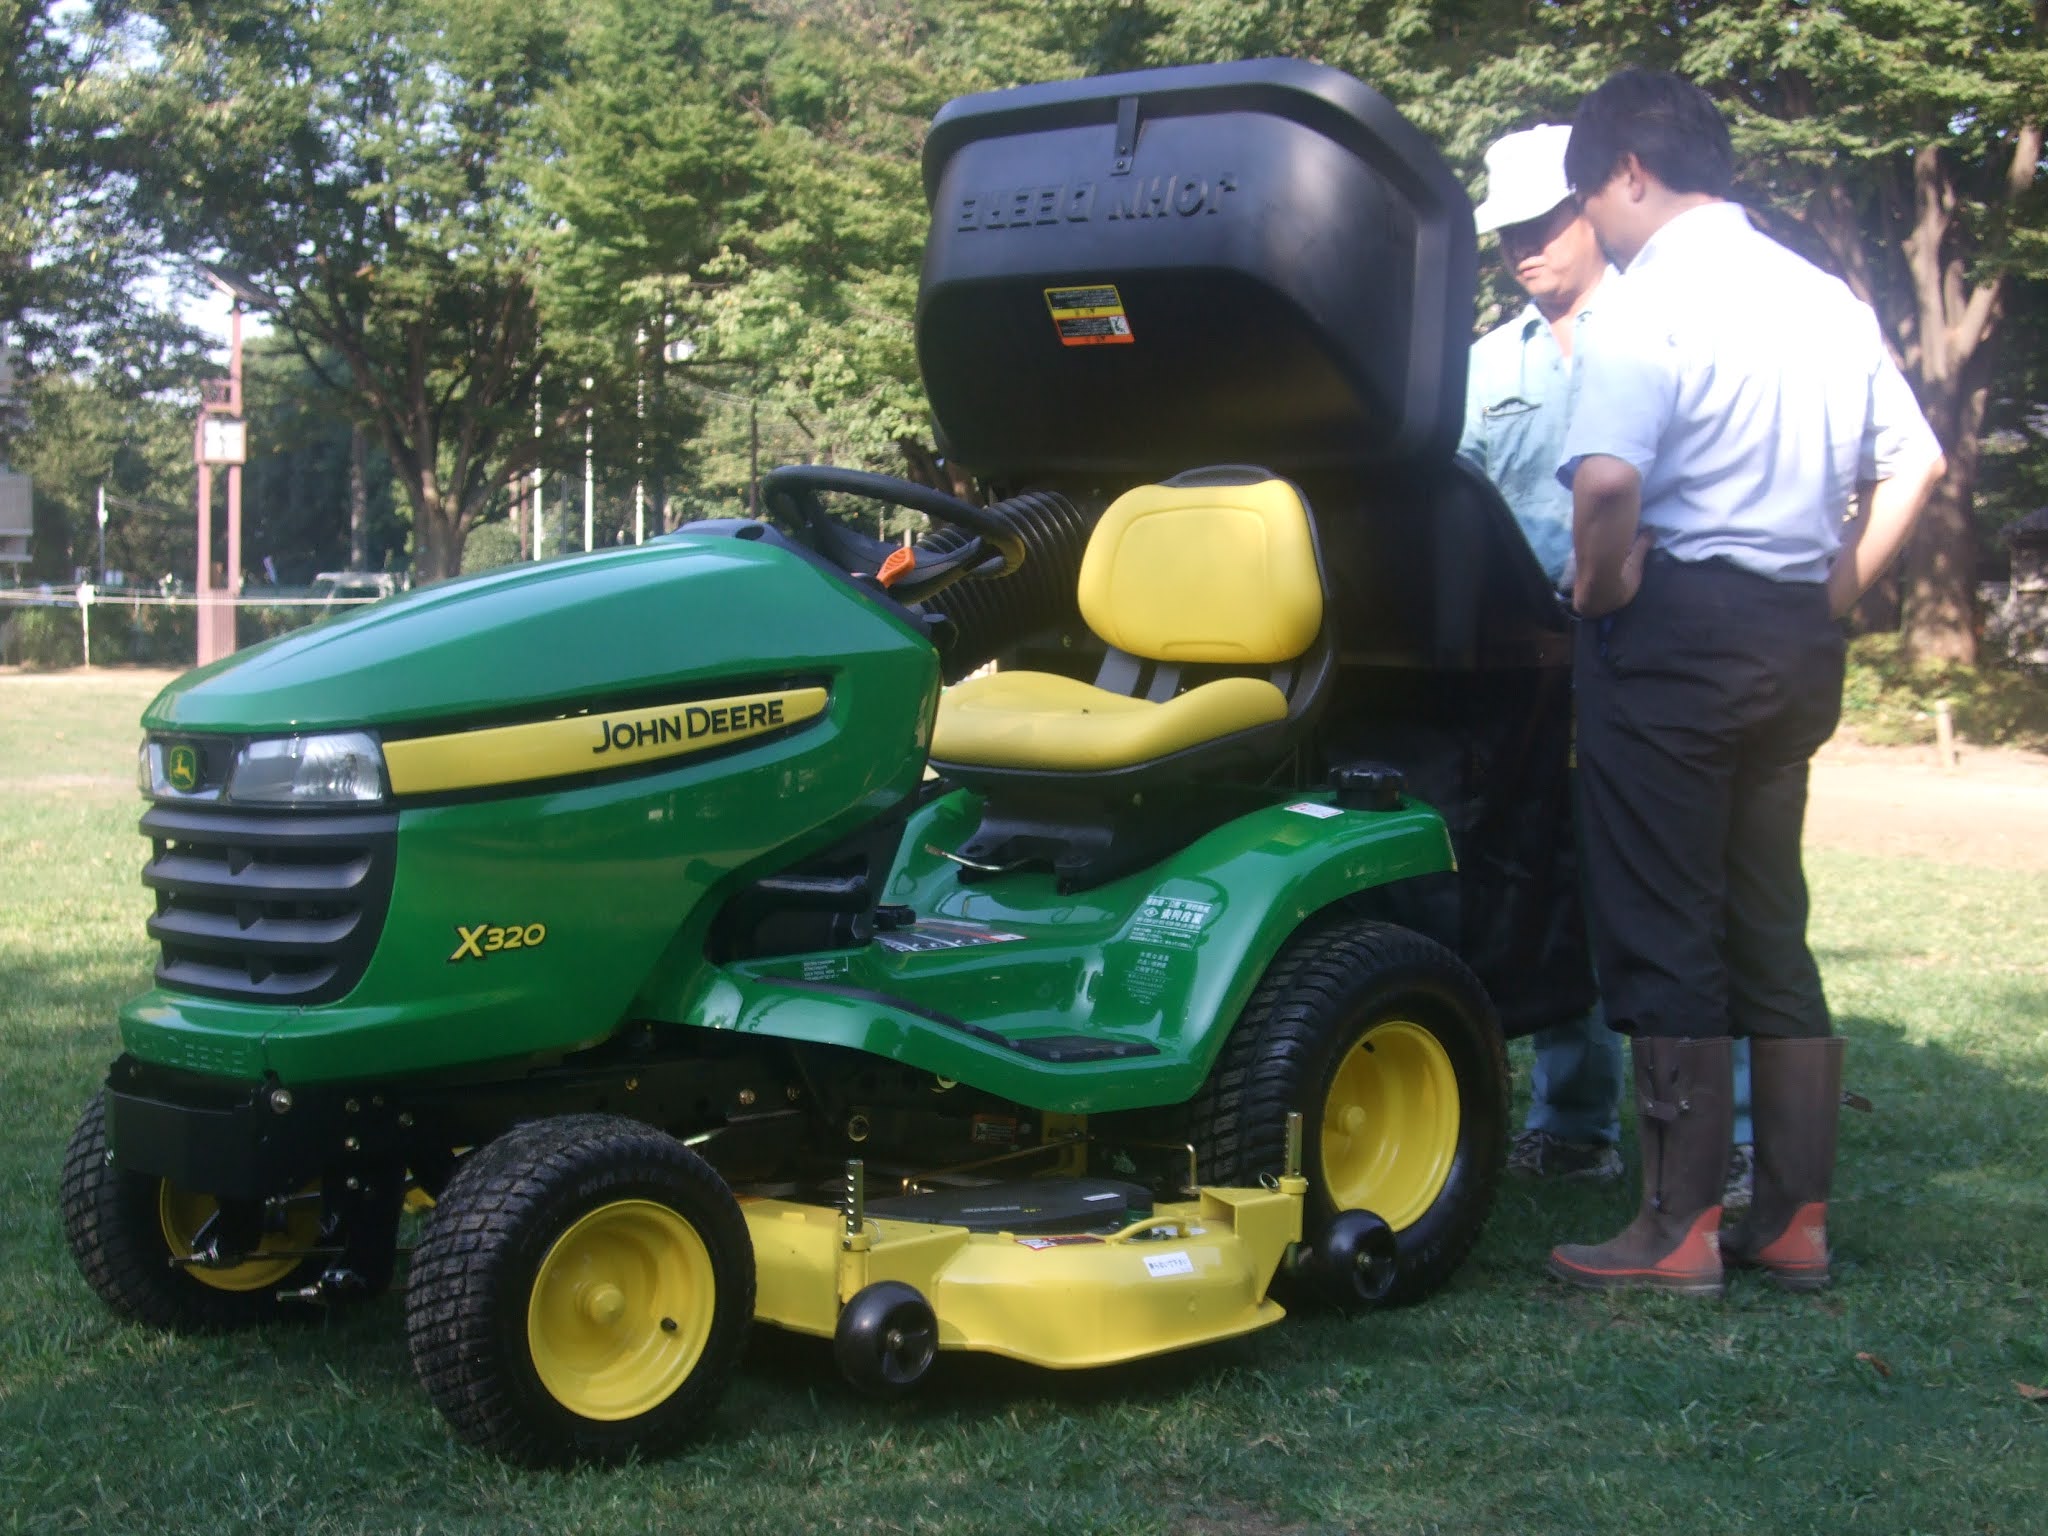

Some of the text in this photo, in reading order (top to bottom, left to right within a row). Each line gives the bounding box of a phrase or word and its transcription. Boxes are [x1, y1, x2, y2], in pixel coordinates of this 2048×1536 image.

[592, 699, 784, 754] JOHN DEERE
[448, 923, 546, 961] X320
